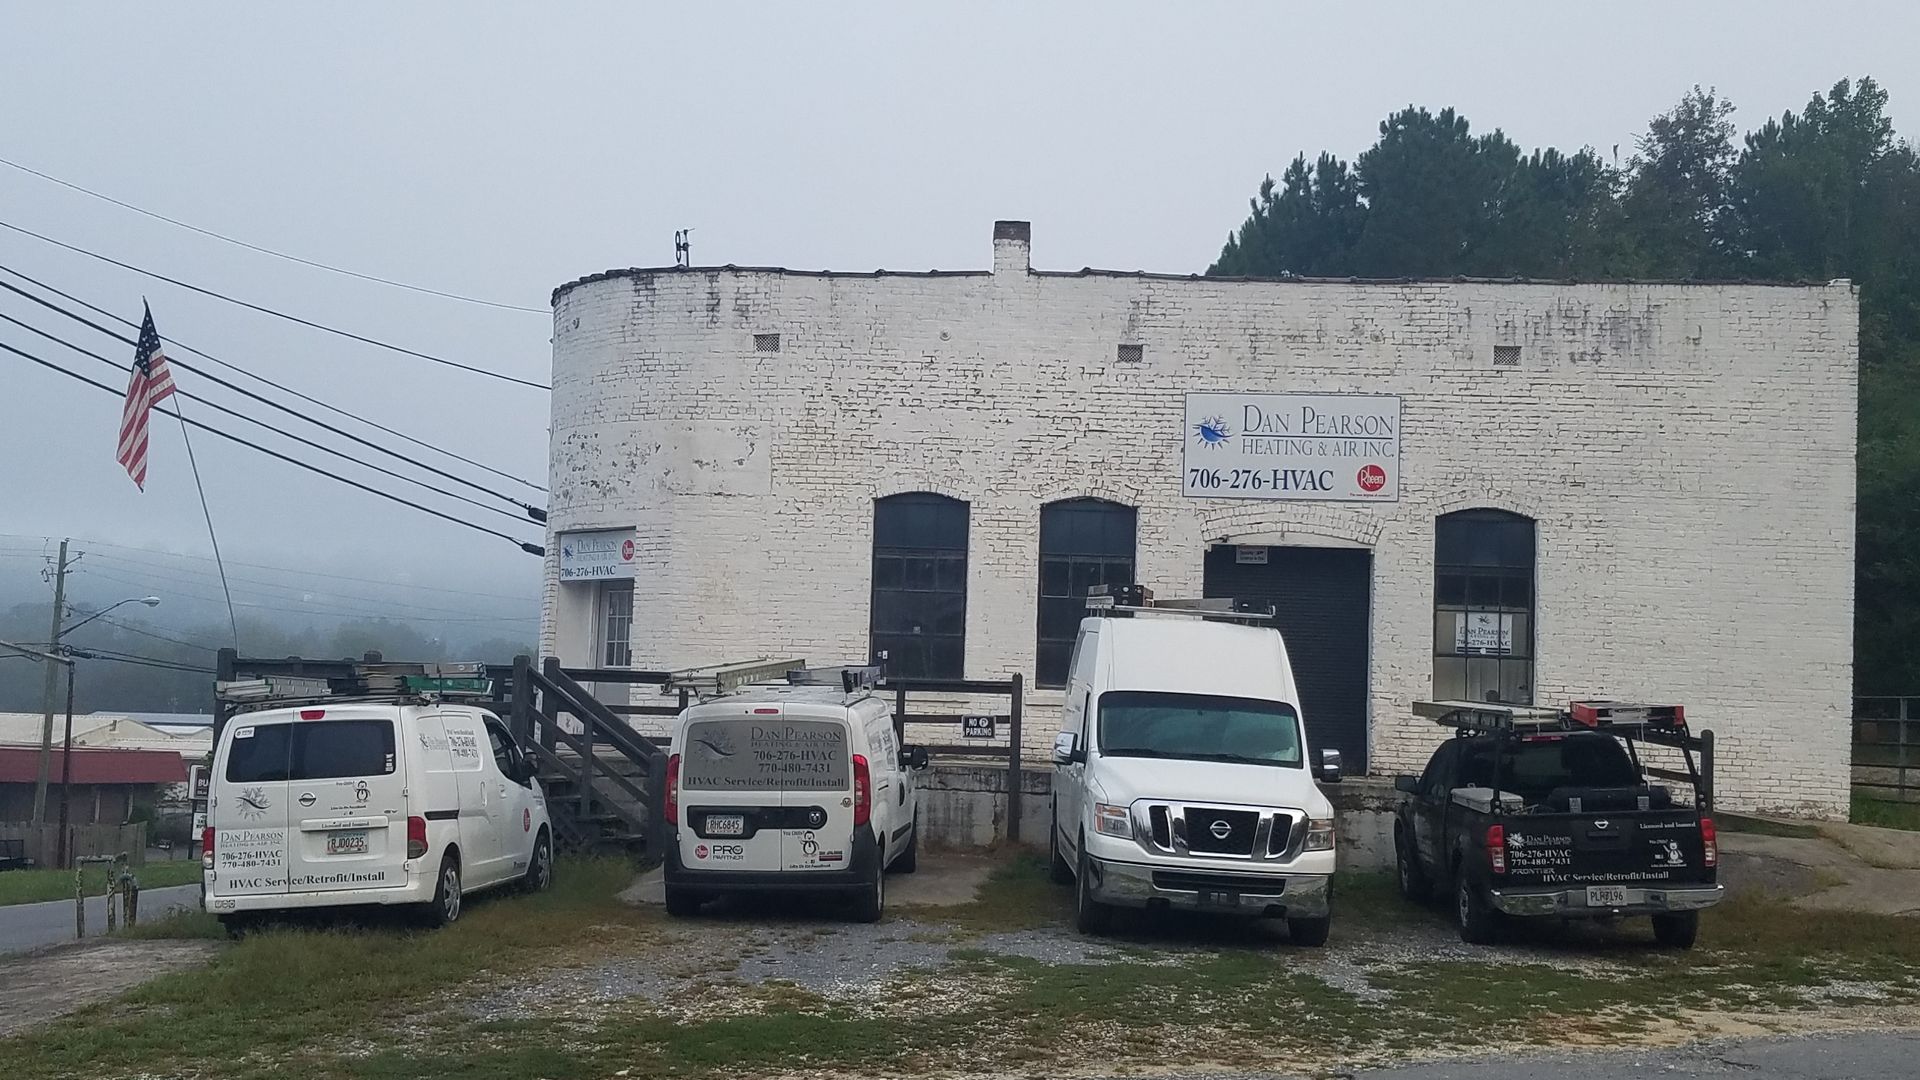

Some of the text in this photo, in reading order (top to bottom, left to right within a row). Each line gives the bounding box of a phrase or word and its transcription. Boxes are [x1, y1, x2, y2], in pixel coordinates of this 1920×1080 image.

[1243, 404, 1394, 435] DAN PEARSON
[1242, 438, 1313, 457] HEATING
[1318, 441, 1328, 457] &
[1332, 440, 1358, 457] AIR
[1189, 468, 1334, 491] 706-276-HVAC
[1360, 466, 1384, 488] Rheem
[561, 564, 617, 578] 706-276-HVAC
[968, 718, 978, 727] NO
[751, 726, 841, 740] DAN PEARSON
[966, 728, 992, 736] PARKING
[753, 750, 837, 760] 706-276-HVAC
[758, 763, 830, 773] 770-480-7431
[688, 776, 720, 785] HVAC
[221, 831, 284, 842] DAN PEARSON
[713, 845, 744, 854] PRO
[1510, 849, 1571, 858] 706-276-HVAC
[221, 850, 283, 860] 706-276-HVAC
[222, 859, 281, 868] 770-480-7431
[1511, 858, 1570, 866] 770-480-7431
[229, 872, 385, 888] HVAC Service/Retrofit/Install
[1543, 871, 1669, 882] HVAC Service/Retrofit/Install
